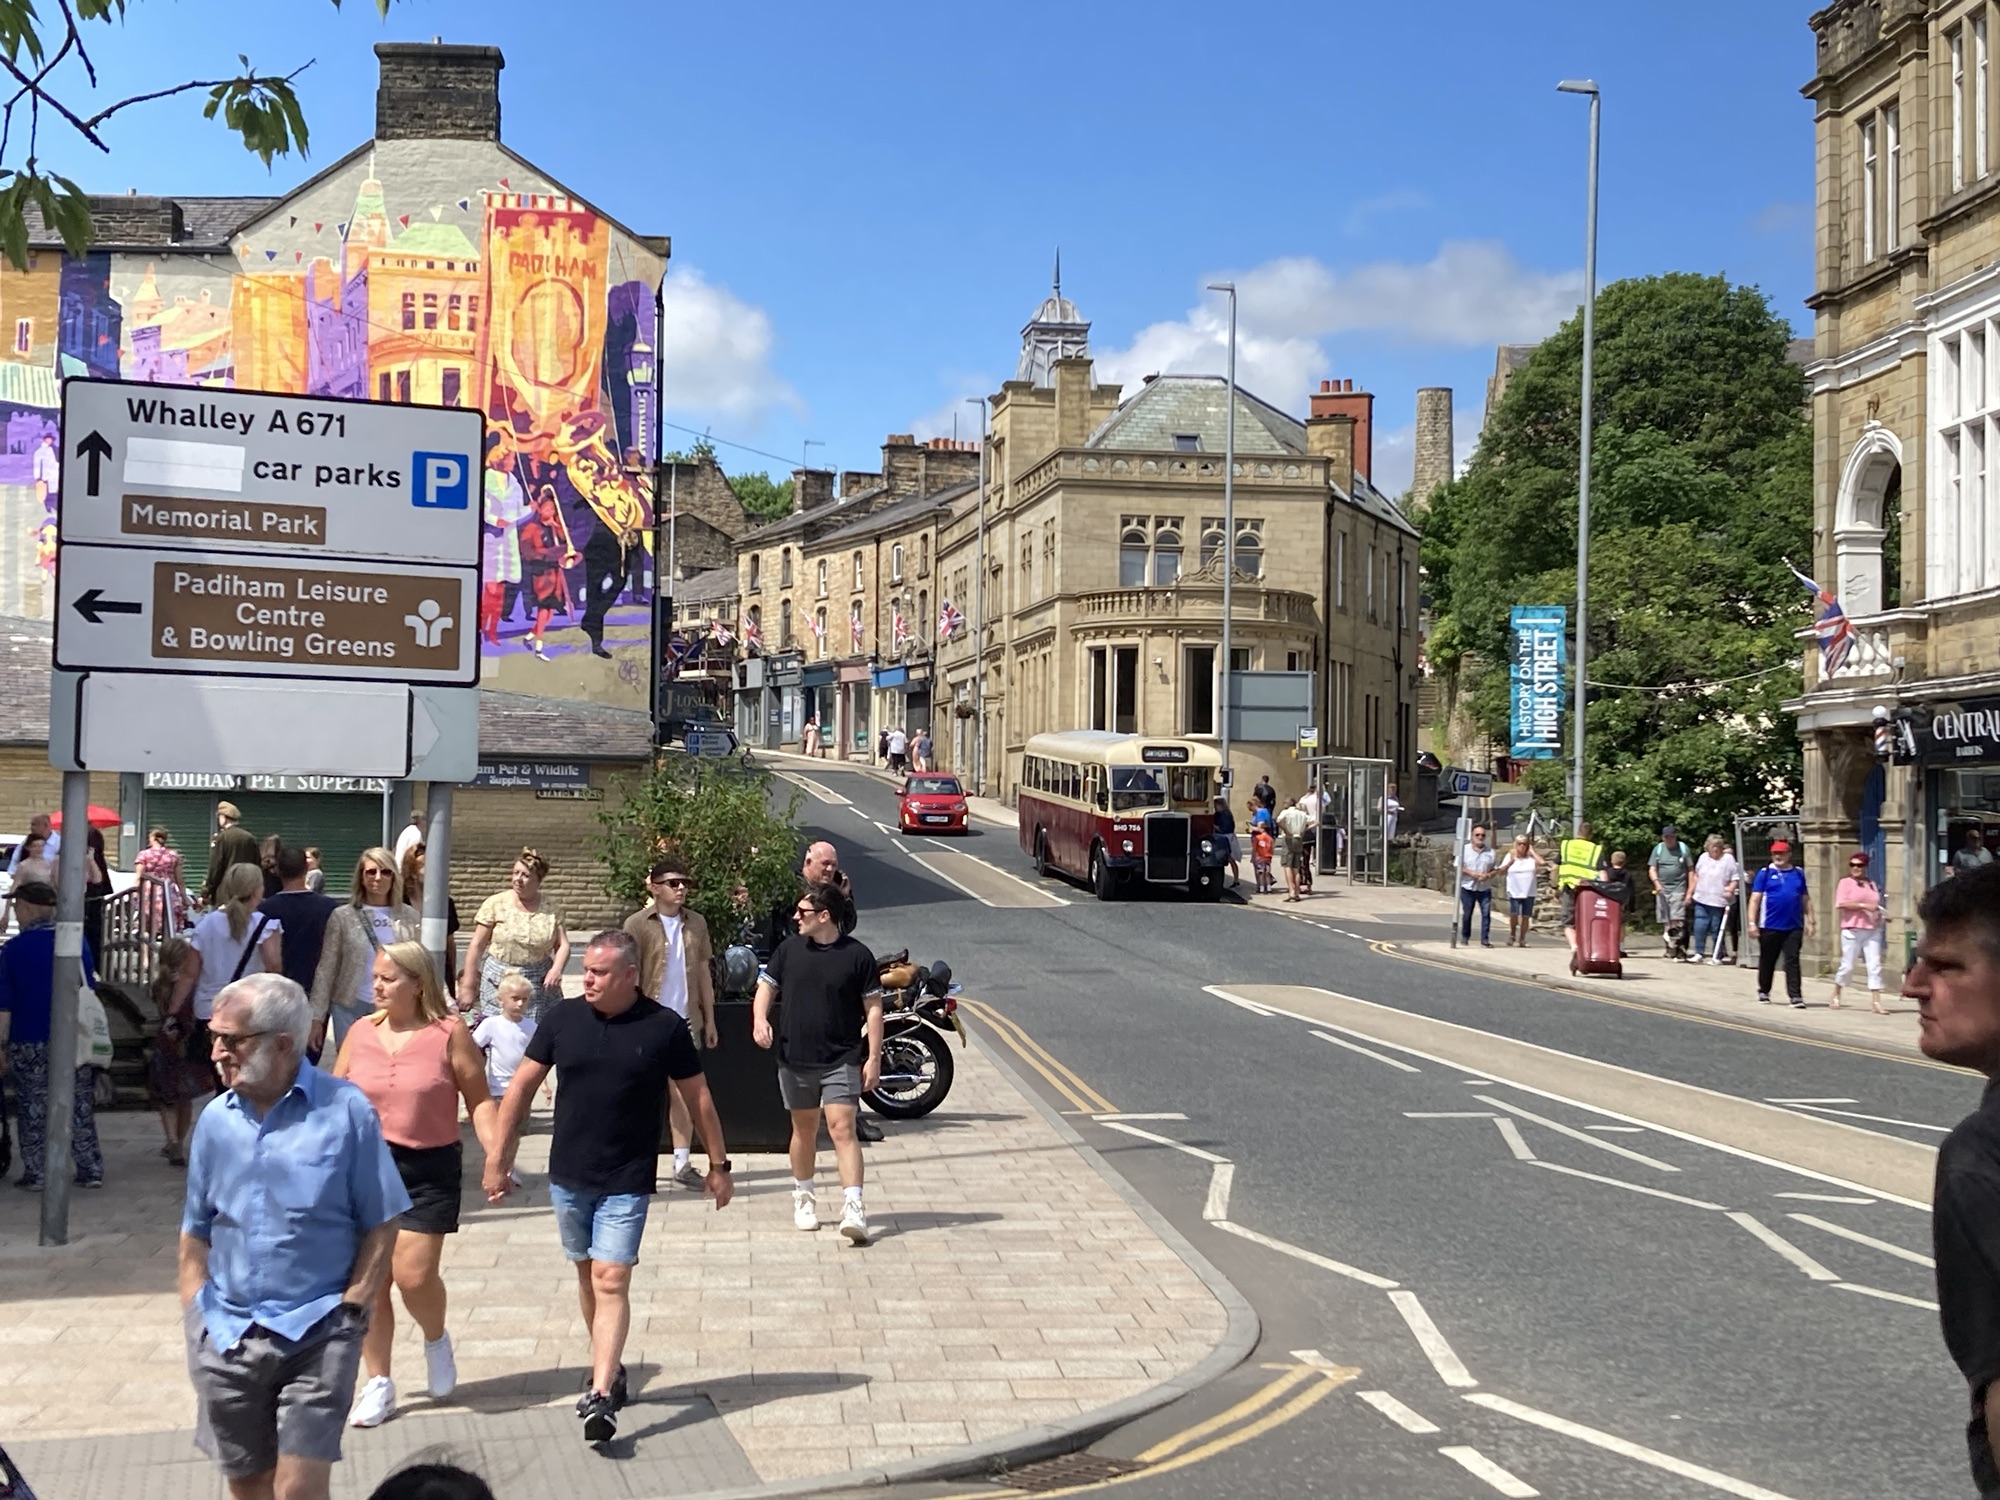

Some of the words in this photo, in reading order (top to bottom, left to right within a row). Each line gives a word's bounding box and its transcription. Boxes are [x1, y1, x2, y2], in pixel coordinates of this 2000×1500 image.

[127, 398, 255, 435] Whalley
[253, 460, 302, 481] car
[315, 463, 401, 488] parks
[425, 459, 461, 503] P
[131, 503, 253, 532] Memorial
[262, 511, 319, 536] Park
[174, 571, 285, 599] Padiham
[297, 578, 388, 604] Leisure
[236, 602, 325, 628] Centre
[161, 626, 179, 648] &
[190, 627, 294, 657] Bowling
[305, 633, 396, 658] Greens
[1519, 628, 1532, 652] THE
[1519, 657, 1532, 679] ON
[1533, 629, 1558, 693] STREET
[1519, 683, 1532, 737] HISTORY
[1533, 697, 1558, 738] HIGH
[1932, 709, 2000, 743] CENTRAL
[488, 775, 531, 787] Supplies
[498, 763, 518, 775] Pet
[534, 764, 579, 776] Wildlife
